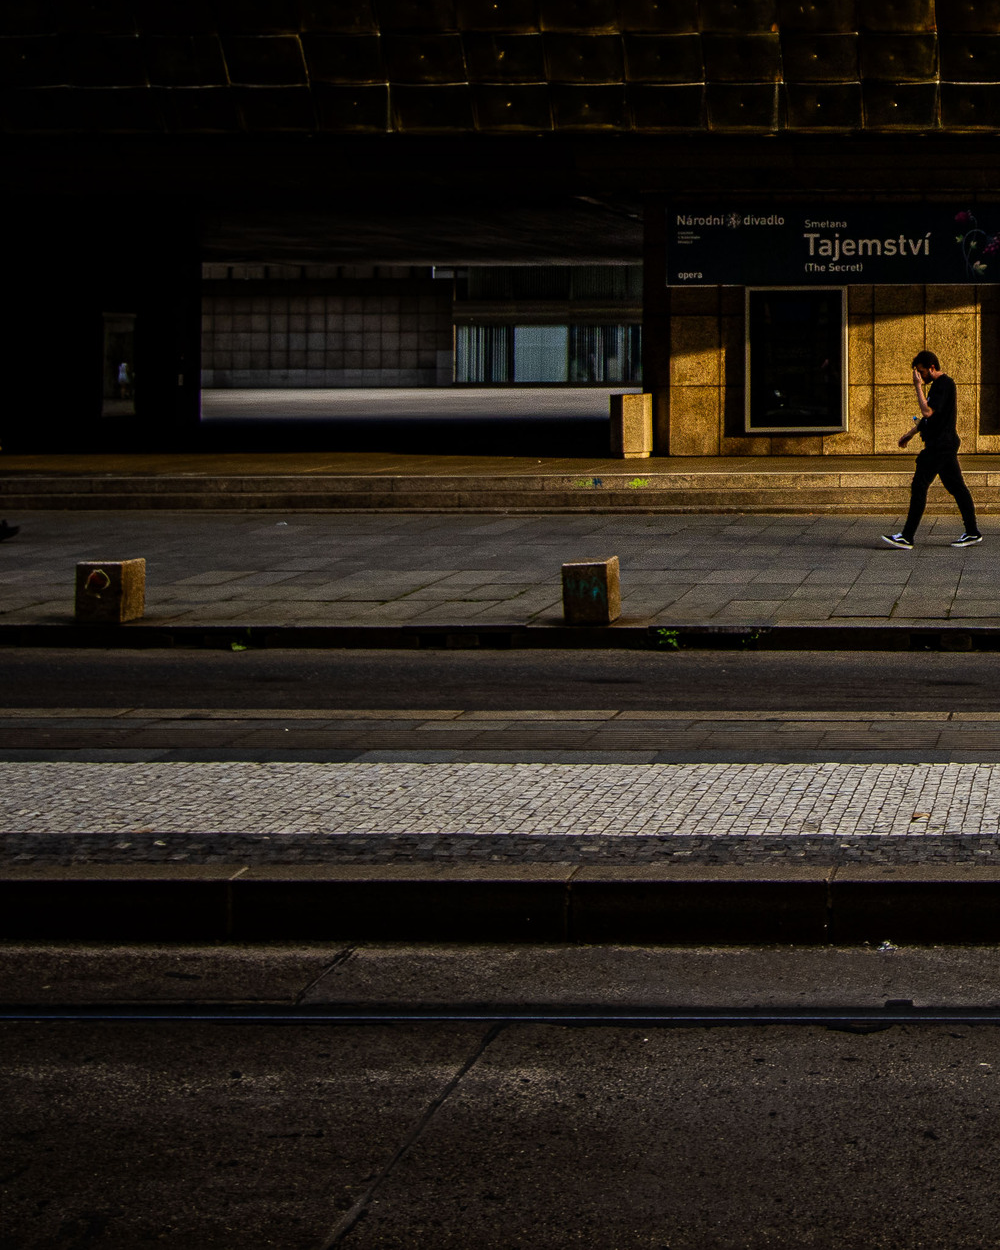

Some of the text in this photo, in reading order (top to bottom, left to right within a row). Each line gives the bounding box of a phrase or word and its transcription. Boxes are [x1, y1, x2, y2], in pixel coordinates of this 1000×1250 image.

[676, 214, 785, 226] Národní divadlo
[804, 219, 848, 229] Smetana
[803, 231, 933, 262] Tajemství
[804, 262, 864, 273] (The Secret)
[677, 271, 703, 280] opera
